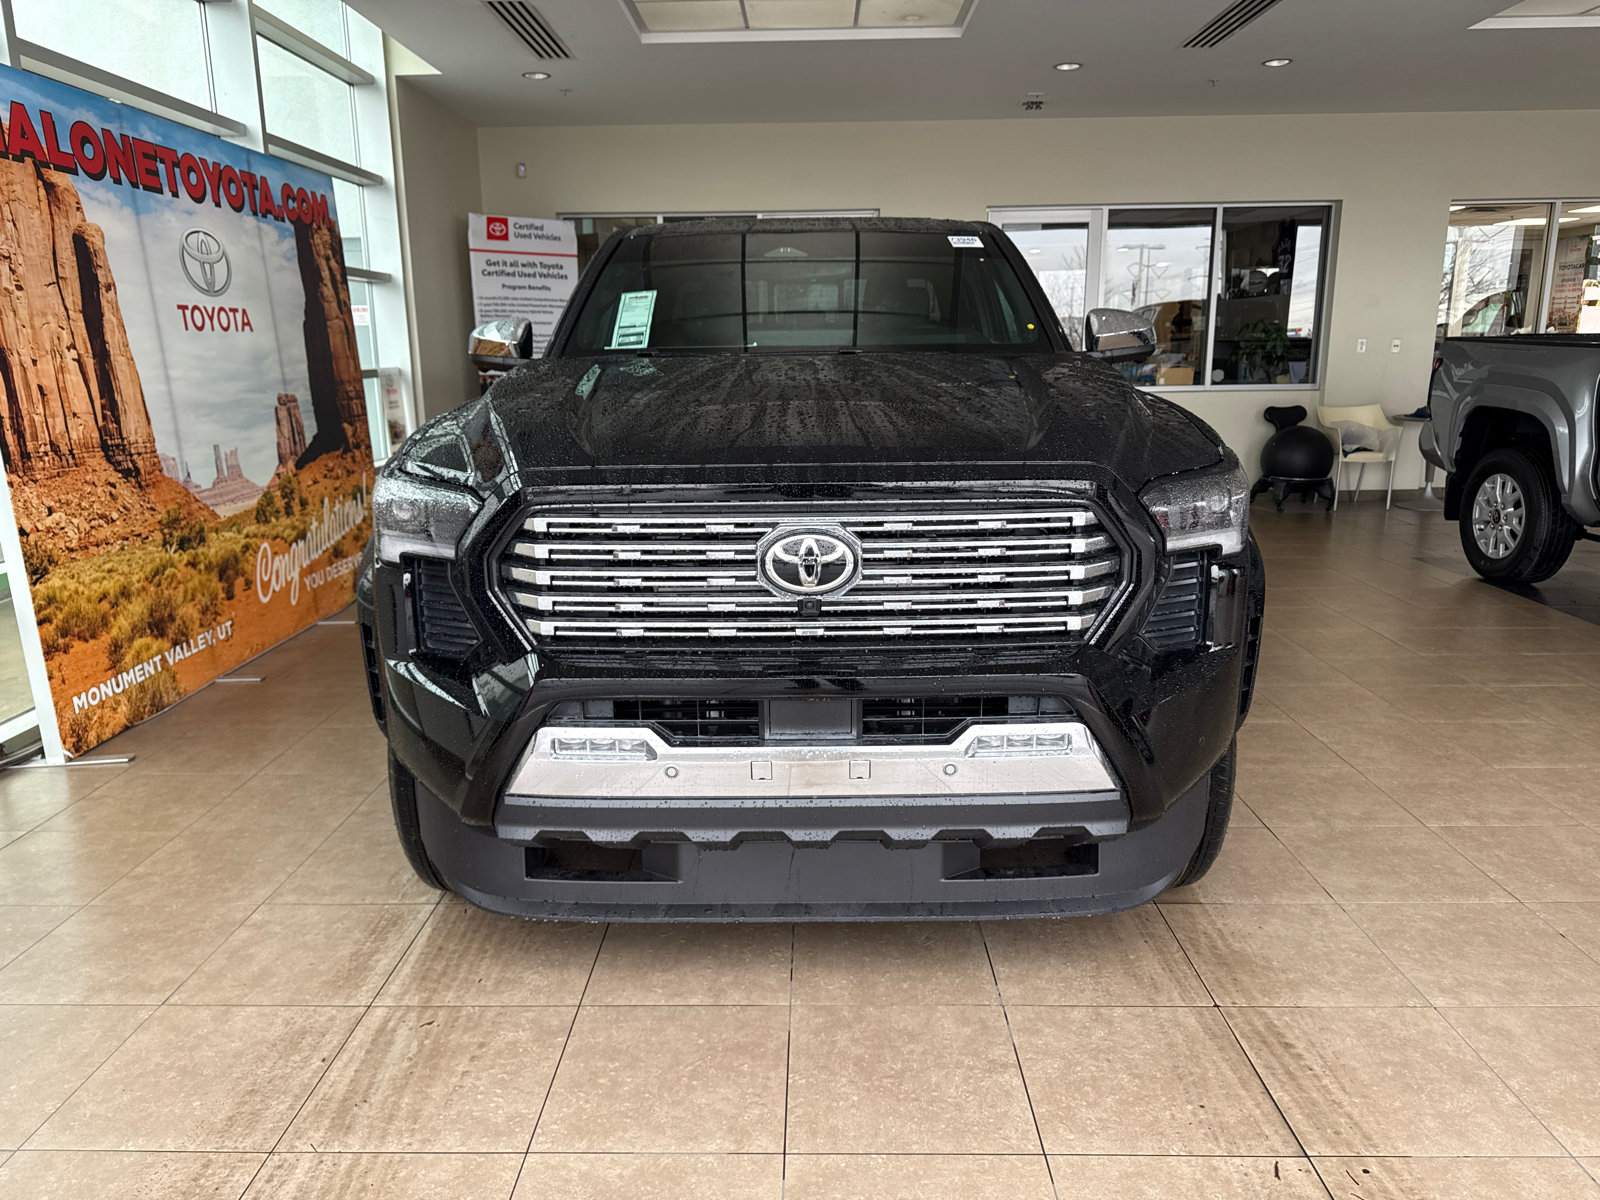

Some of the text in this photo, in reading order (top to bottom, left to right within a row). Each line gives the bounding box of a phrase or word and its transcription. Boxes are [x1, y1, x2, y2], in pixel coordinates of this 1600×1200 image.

[0, 100, 331, 230] ALONETOYOTA.COM
[513, 222, 544, 232] Certified
[513, 231, 561, 242] Used Vehicles
[486, 259, 564, 271] Get it all with Toyota
[482, 269, 568, 280] Certified Used Vehicles
[502, 283, 527, 292] Program
[176, 303, 254, 333] TOYOTA
[256, 470, 368, 606] Congratulations!
[304, 570, 325, 591] YOU
[72, 620, 233, 715] MONUMENT VALLEY, UT
